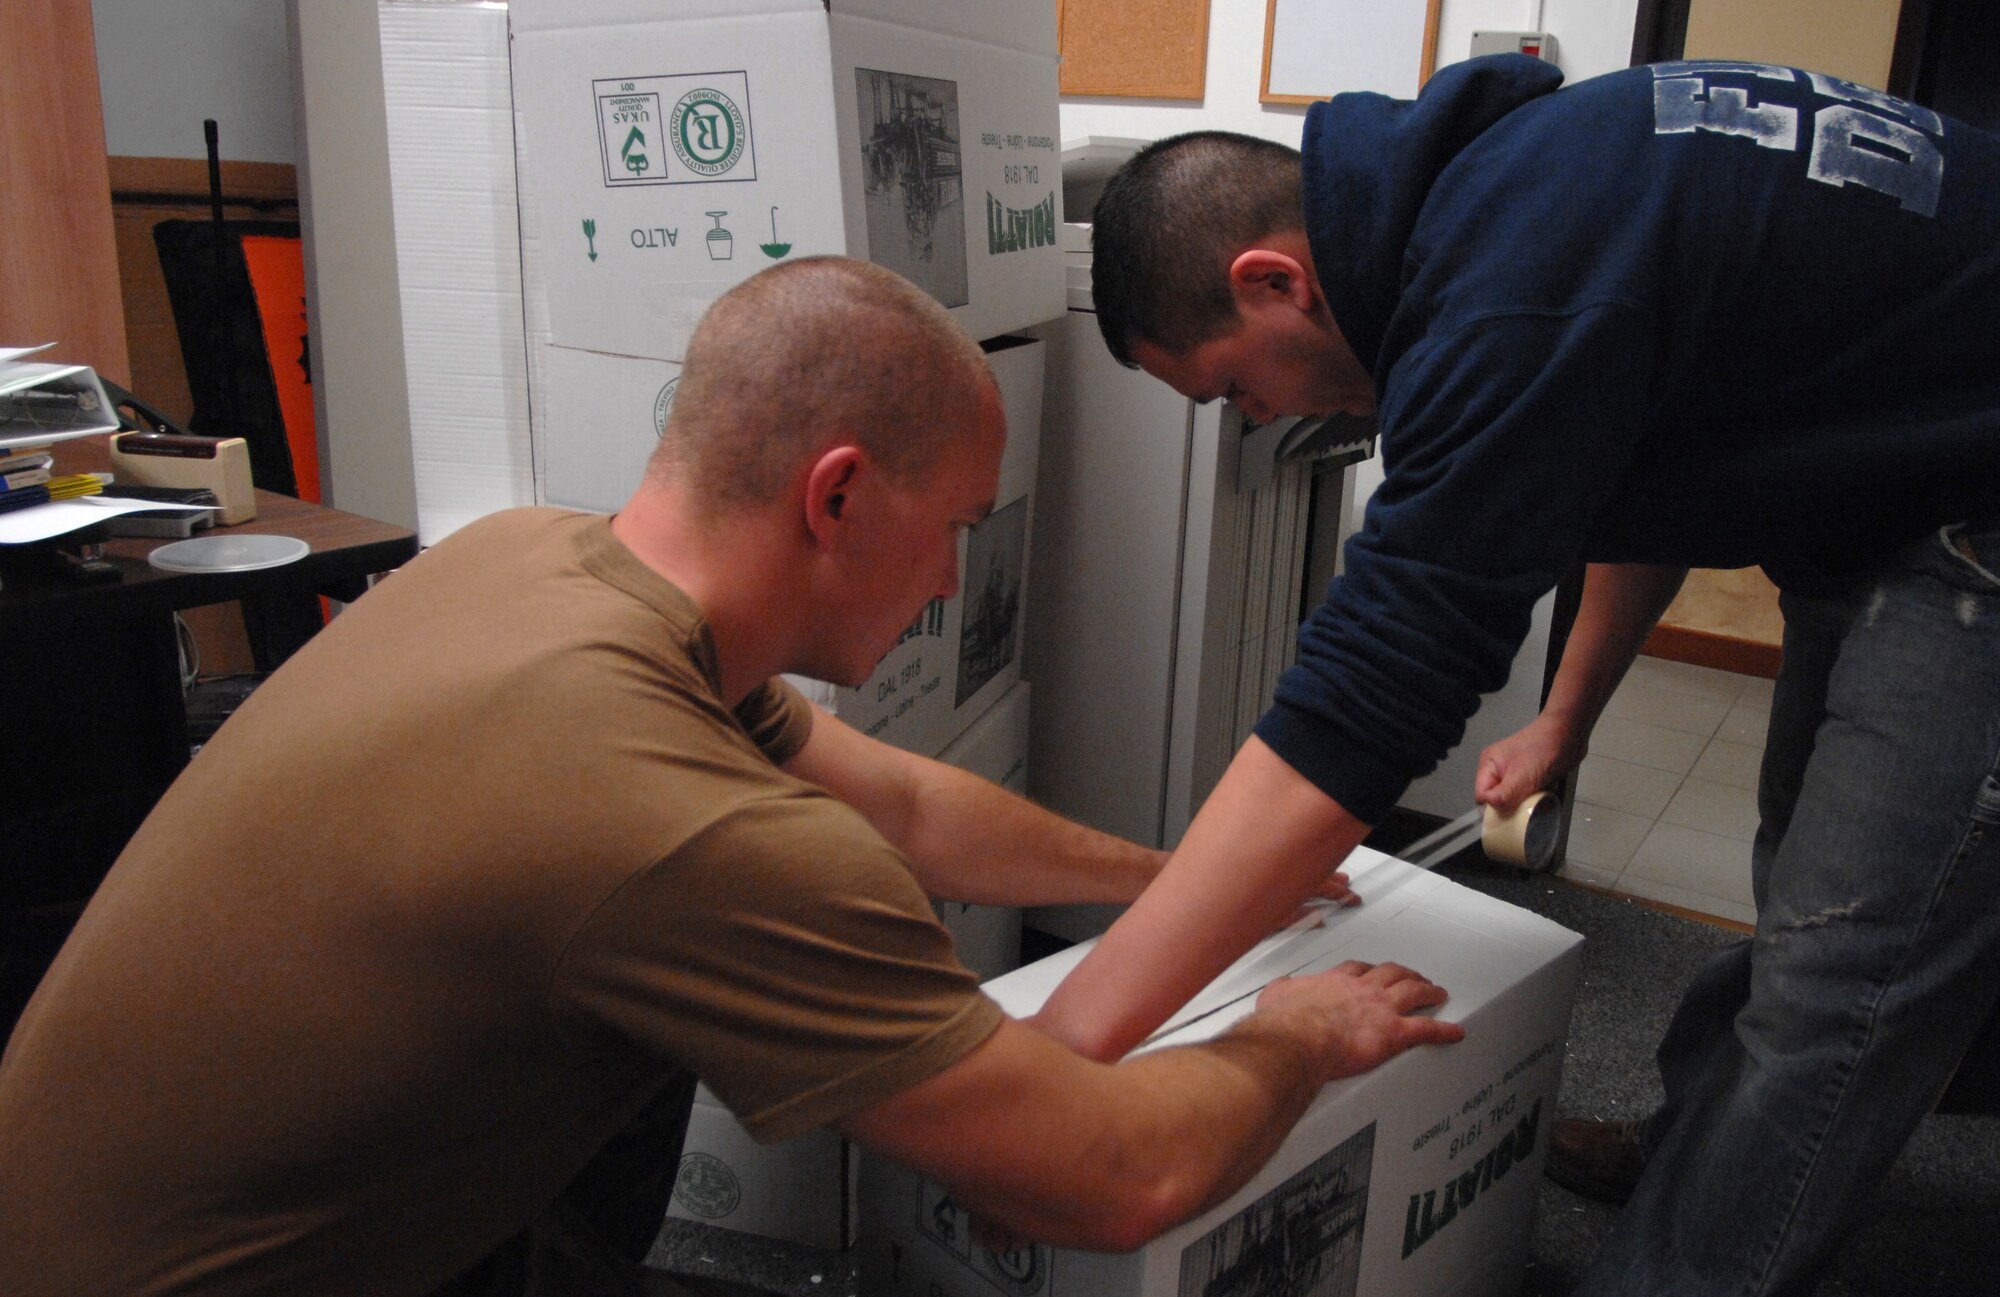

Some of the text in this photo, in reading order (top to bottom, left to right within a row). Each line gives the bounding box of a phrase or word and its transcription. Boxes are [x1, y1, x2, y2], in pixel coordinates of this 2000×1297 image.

[620, 82, 635, 91] 001
[609, 97, 650, 106] MANAGEMENT
[612, 110, 650, 124] UKAS
[671, 106, 687, 158] ASSURANCE
[981, 133, 1002, 150] Trieste
[1007, 134, 1023, 151] Udine
[718, 137, 743, 171] REGISTER
[684, 158, 718, 173] QUALITY
[1004, 165, 1039, 184] DAL 1918
[630, 227, 679, 249] ALTO
[877, 658, 922, 703] DAL 1918
[1462, 1084, 1493, 1116] Udine
[1412, 1116, 1452, 1152] Trieste
[1448, 1094, 1516, 1160] DAL 1918
